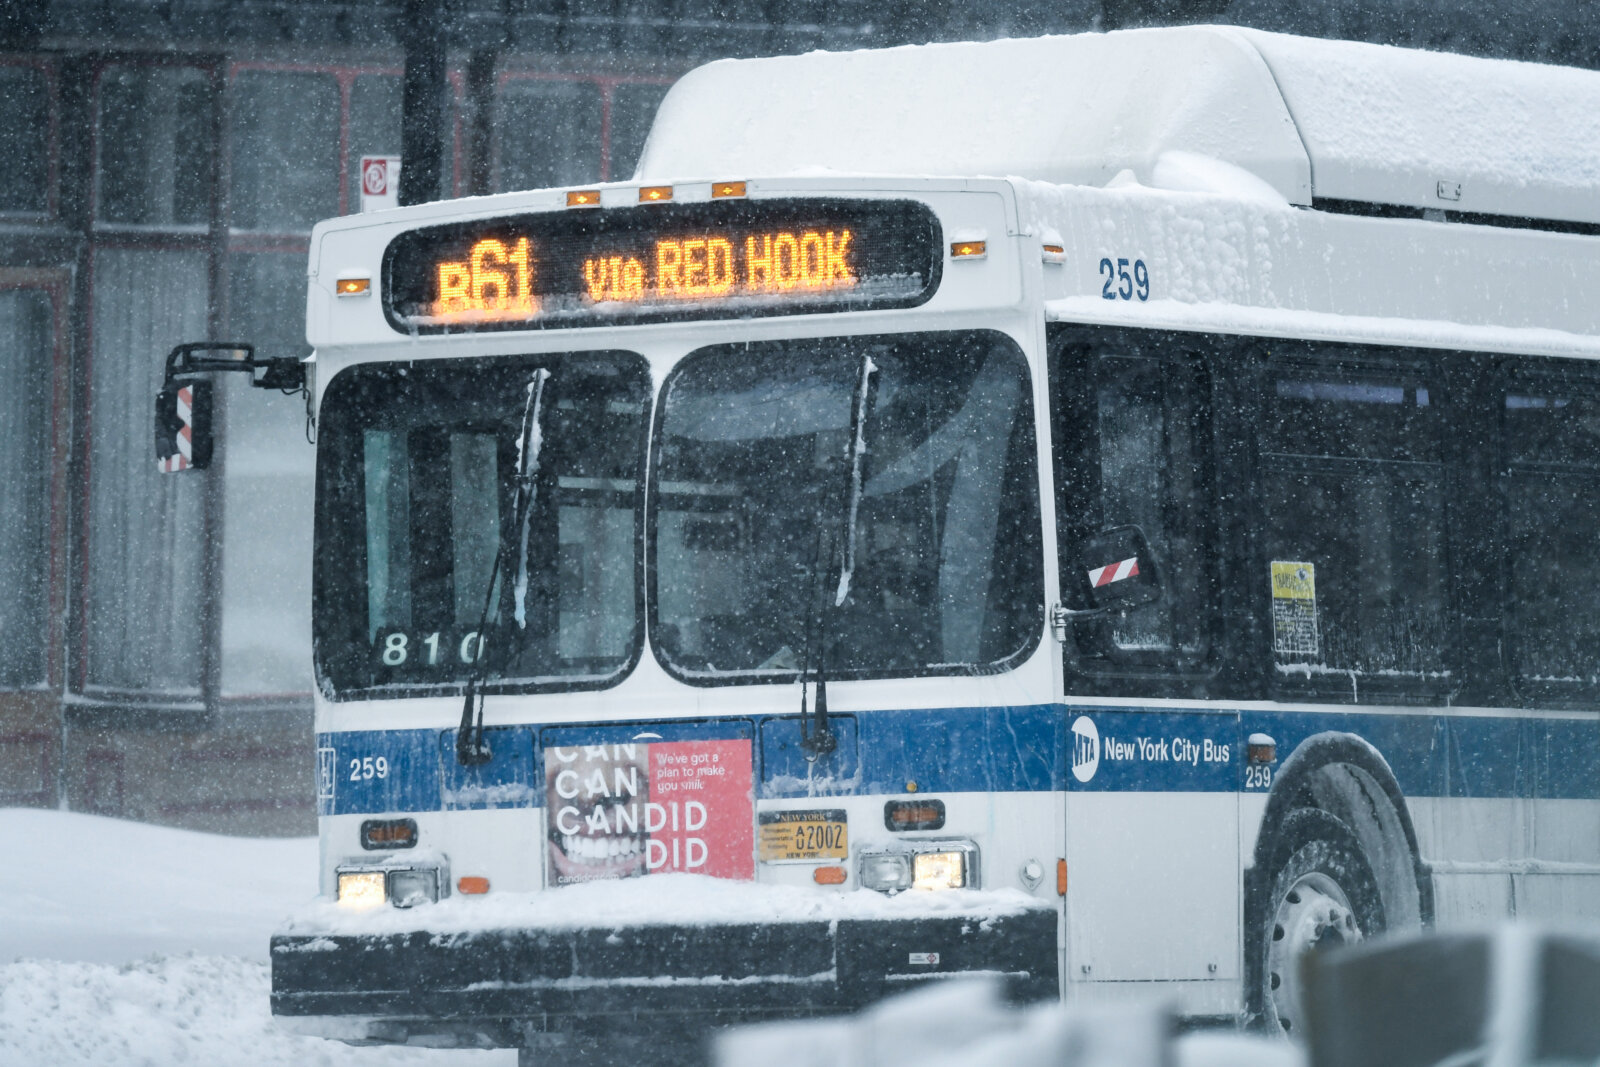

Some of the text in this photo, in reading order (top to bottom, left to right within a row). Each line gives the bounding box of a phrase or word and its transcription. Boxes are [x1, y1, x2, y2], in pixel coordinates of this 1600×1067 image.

[439, 236, 530, 315] B61
[656, 239, 732, 294] RED
[746, 229, 853, 290] HOOK
[1099, 257, 1150, 302] 259
[656, 752, 719, 766] We've got a
[1104, 736, 1230, 767] New York City Bus
[349, 756, 389, 782] 259
[657, 764, 726, 780] plan to make
[1245, 765, 1272, 789] 259
[555, 766, 638, 799] CAN
[657, 782, 678, 794] you
[556, 801, 708, 836] CANDID
[780, 812, 826, 822] NEW YORK
[806, 824, 843, 850] 2002
[645, 836, 709, 869] DID
[786, 851, 801, 859] NEW
